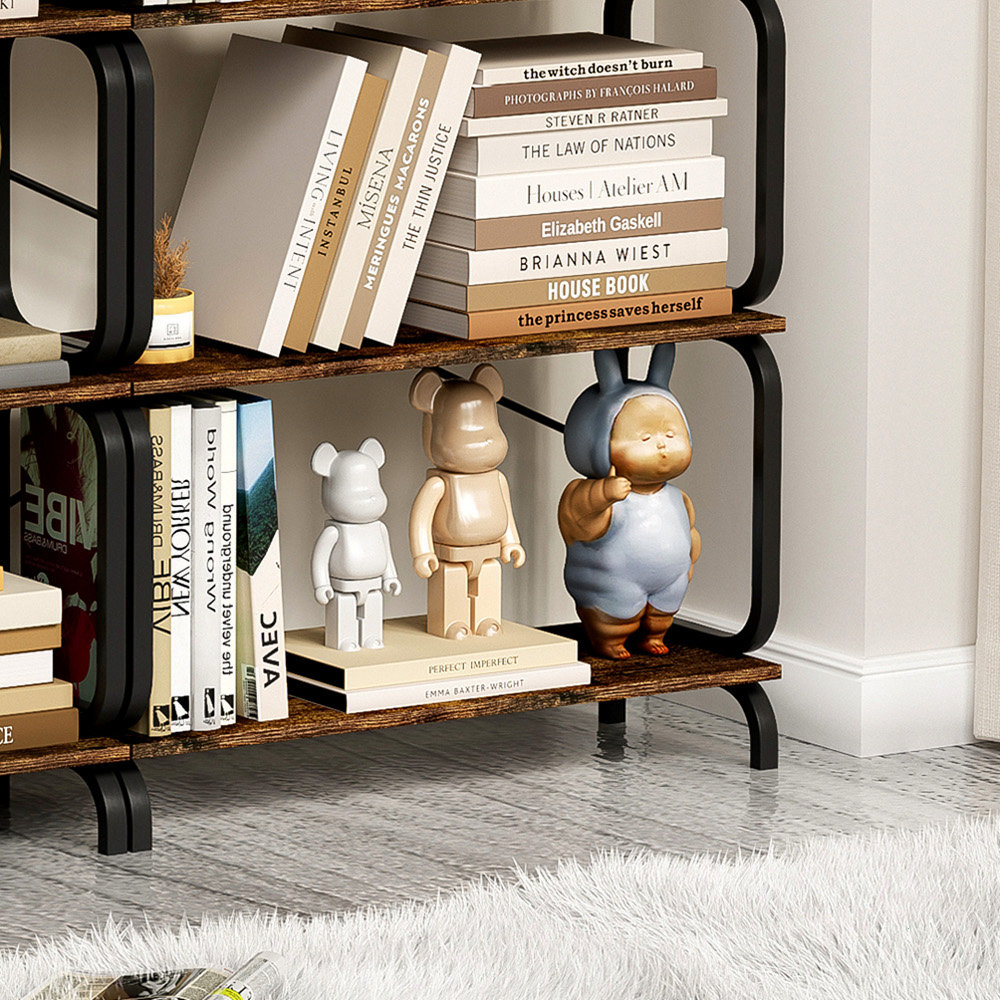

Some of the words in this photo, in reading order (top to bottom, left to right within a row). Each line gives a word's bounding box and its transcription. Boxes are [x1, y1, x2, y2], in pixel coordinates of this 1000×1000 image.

[523, 67, 547, 80] the
[548, 65, 586, 78] witch
[641, 58, 673, 71] burn
[311, 129, 343, 201] LIVING
[364, 194, 400, 290] MERINGUES
[394, 97, 430, 190] MACARONS
[318, 166, 353, 257] INSTANBUL
[541, 217, 606, 238] Elizabeth
[609, 211, 662, 232] Gaskell
[284, 217, 316, 293] INTENT
[519, 250, 606, 271] BRIANNA
[616, 243, 671, 262] WIEST
[548, 280, 601, 301] HOUSE
[605, 273, 649, 295] BOOK
[428, 662, 466, 674] PERFECT
[470, 656, 519, 671] IMPERFECT
